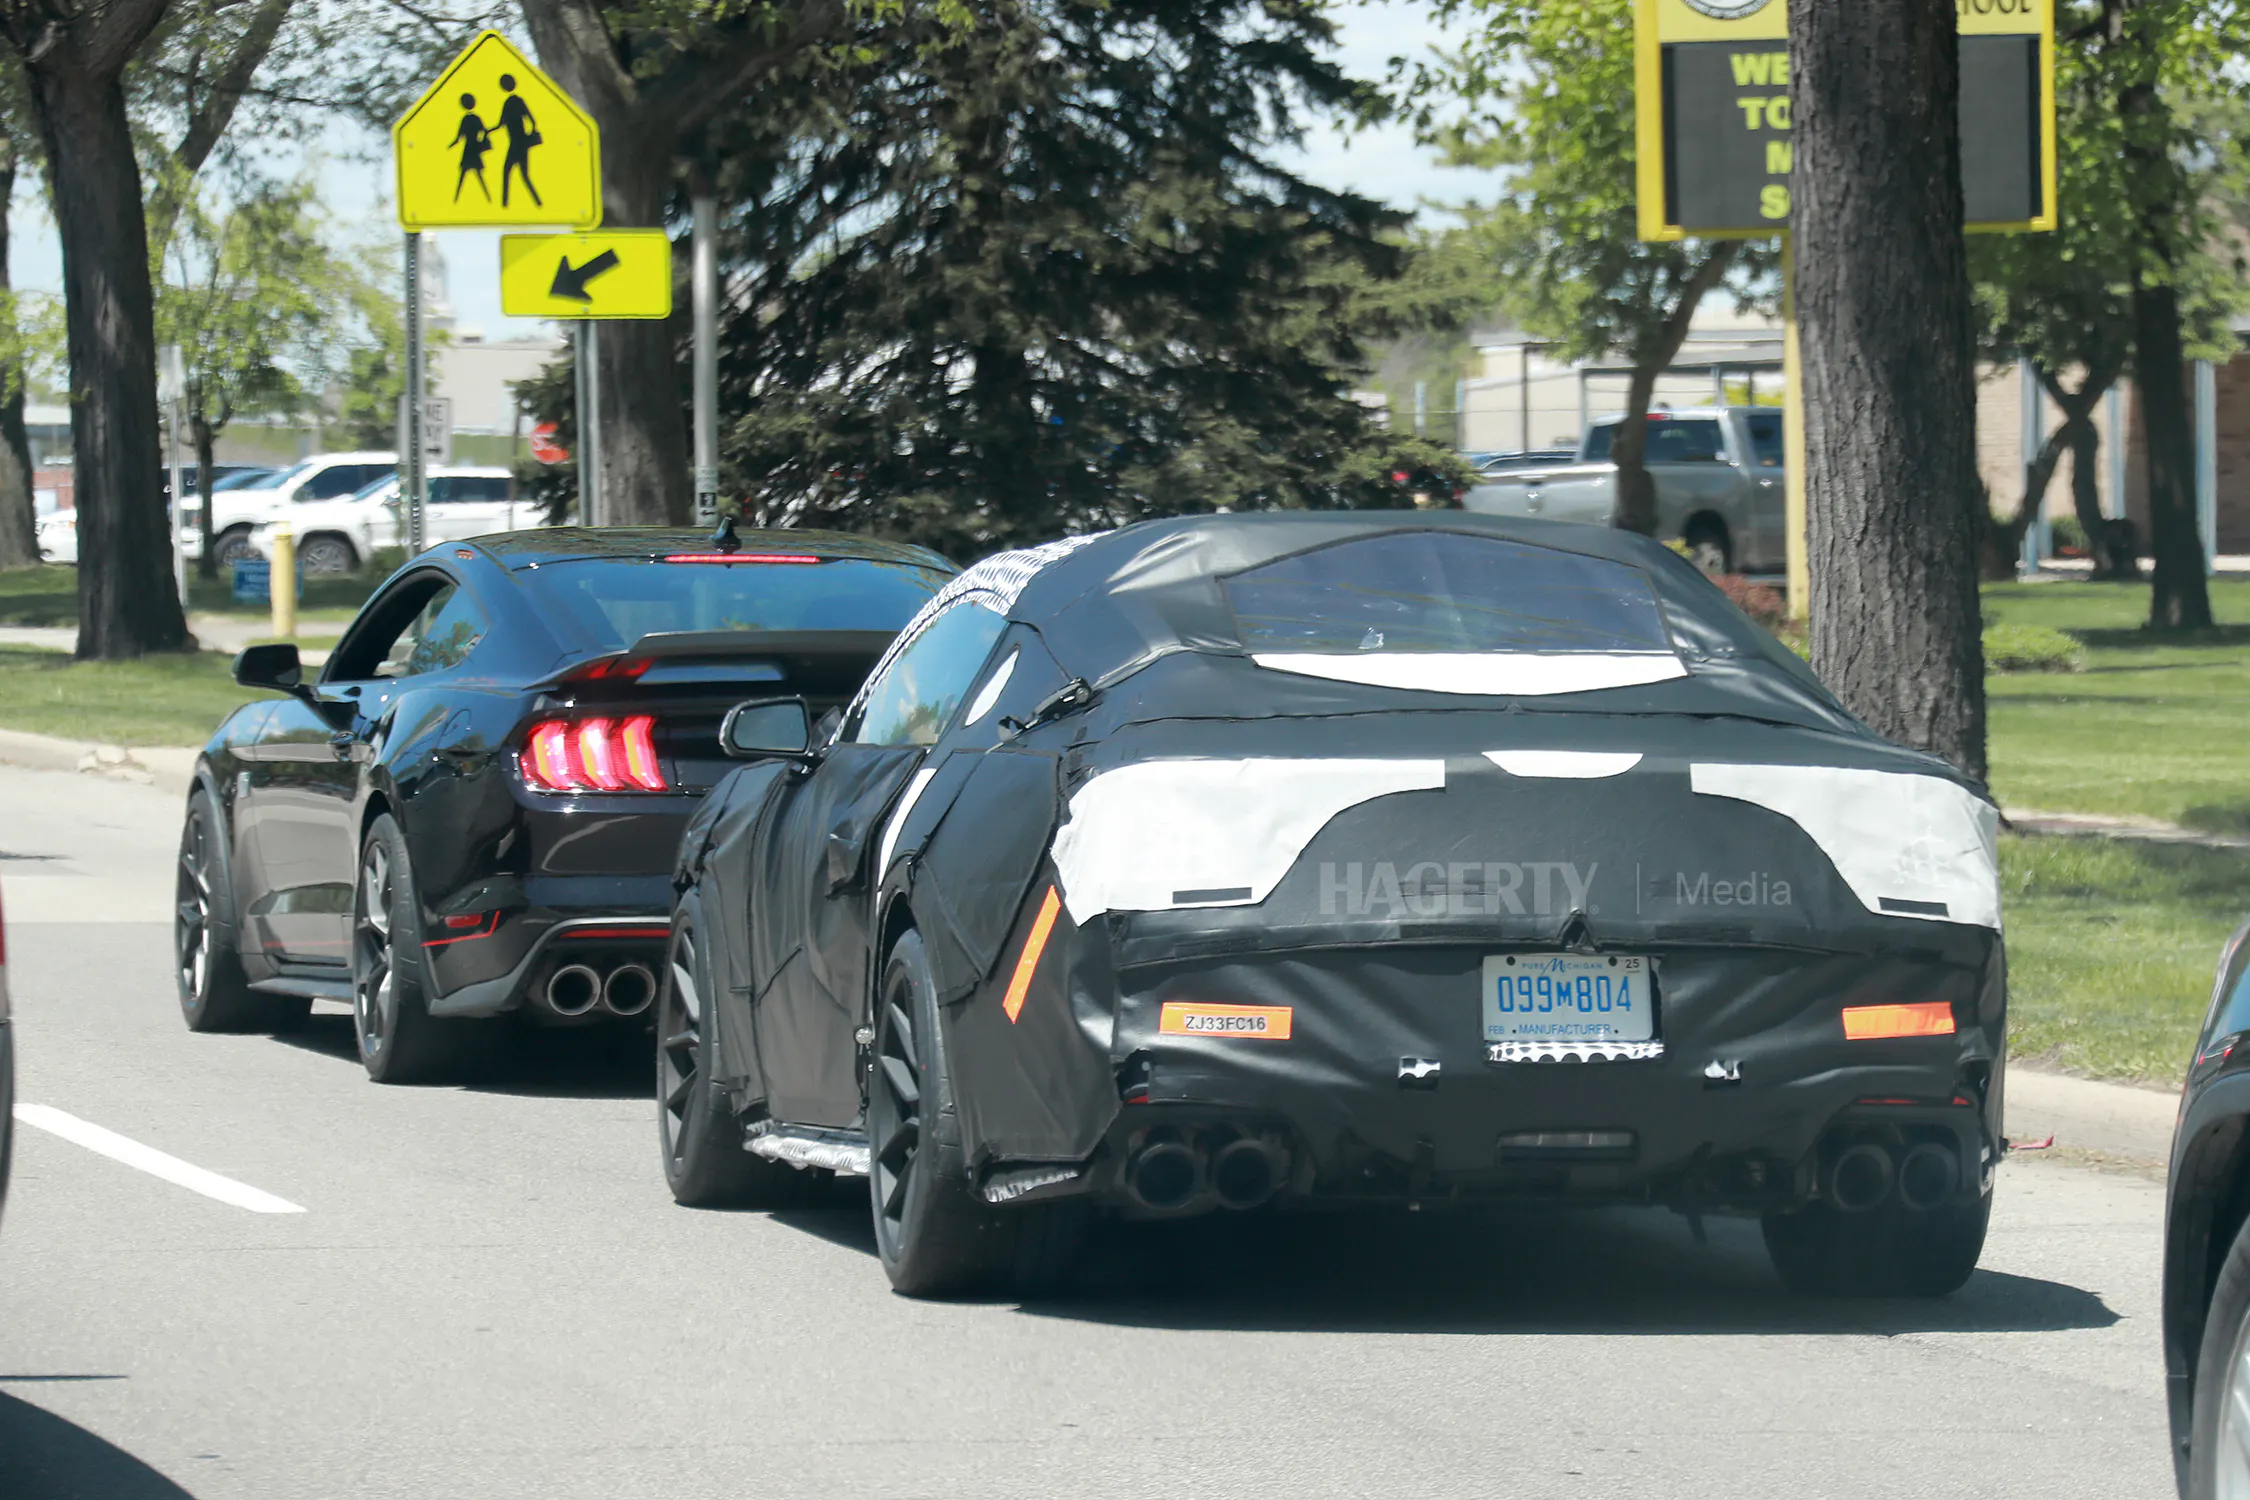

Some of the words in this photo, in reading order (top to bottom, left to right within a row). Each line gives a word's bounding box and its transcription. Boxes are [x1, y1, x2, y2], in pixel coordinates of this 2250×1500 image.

[1521, 962, 1544, 970] PURE
[1625, 958, 1640, 969] 25
[1497, 975, 1632, 1013] 099M804
[1185, 1015, 1266, 1031] ZJ33FC16
[1518, 1023, 1611, 1035] MANUFACTURER
